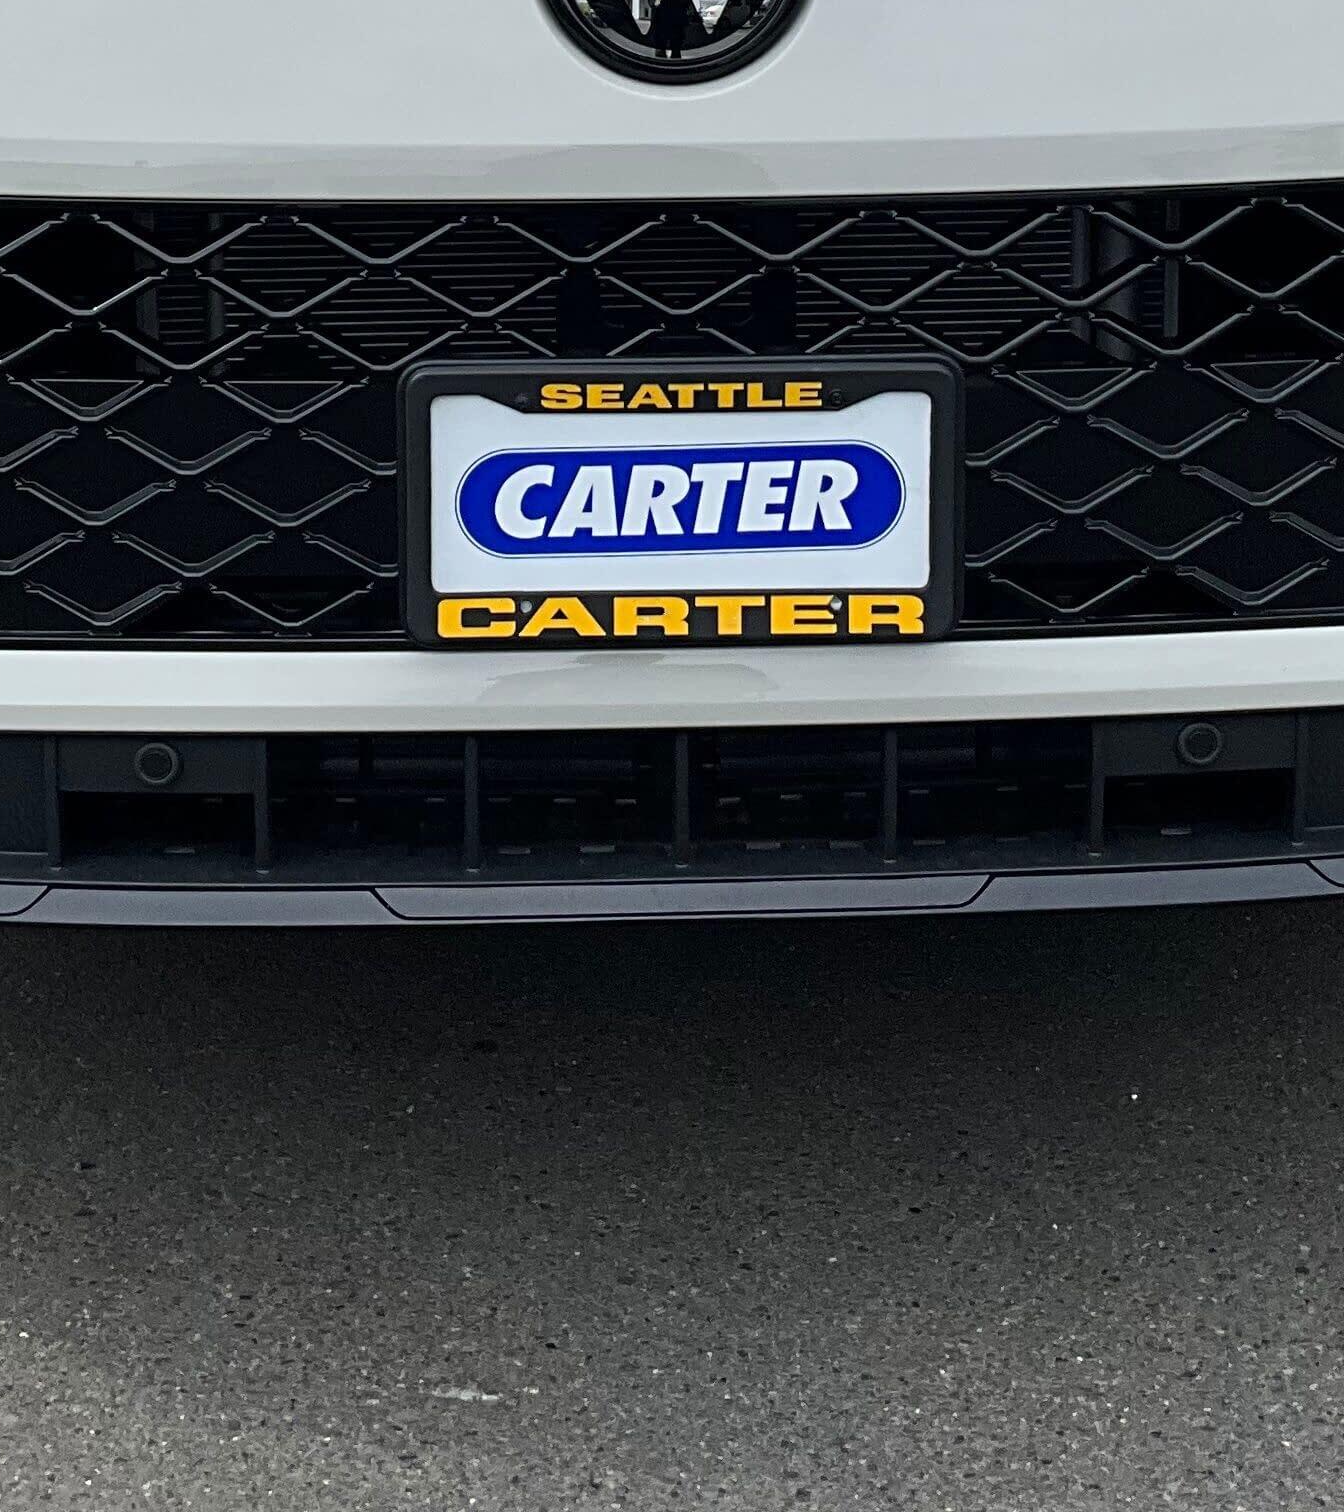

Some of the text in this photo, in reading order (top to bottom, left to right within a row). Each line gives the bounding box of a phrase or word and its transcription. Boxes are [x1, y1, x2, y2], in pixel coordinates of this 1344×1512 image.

[540, 382, 823, 410] SEATTLE
[494, 459, 858, 540] CARTER
[437, 594, 925, 639] CARTER
